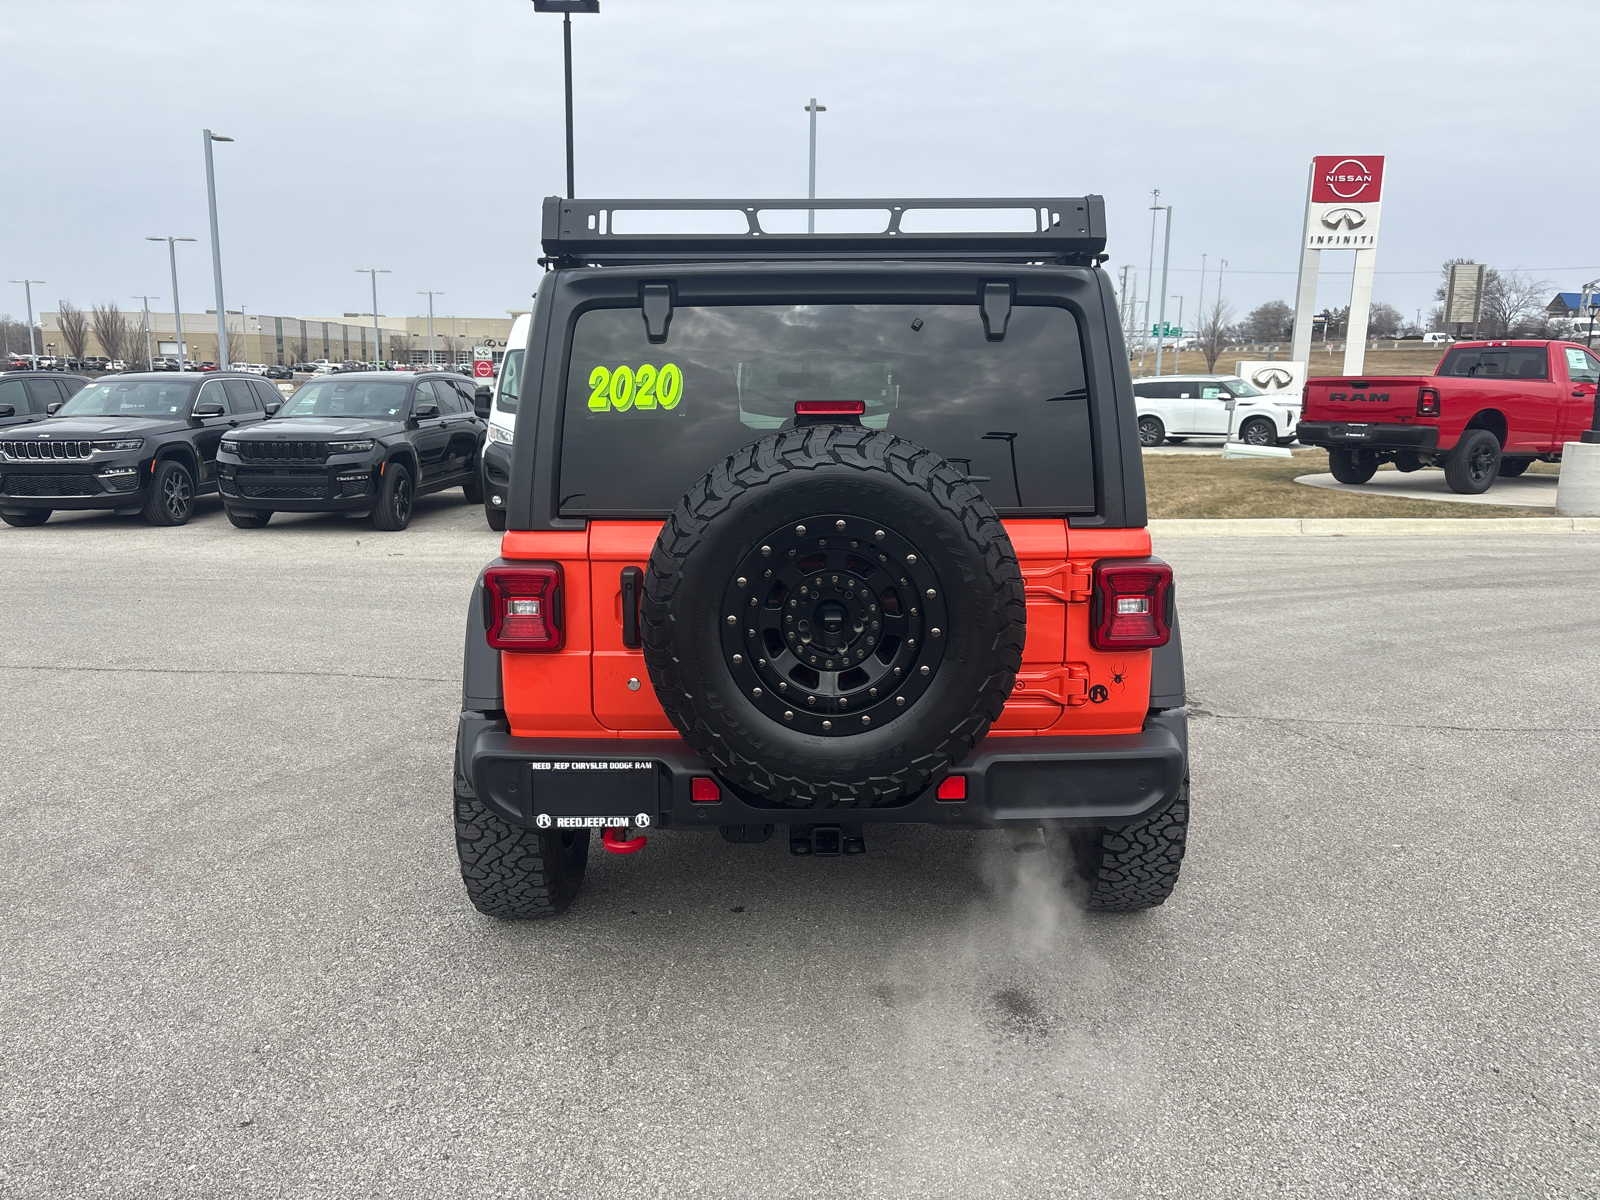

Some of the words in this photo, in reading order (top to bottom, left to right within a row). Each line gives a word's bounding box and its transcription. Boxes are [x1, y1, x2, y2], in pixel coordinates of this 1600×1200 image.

[1309, 236, 1374, 245] INFINITI
[587, 363, 684, 412] 2020
[1329, 393, 1390, 402] RAM
[532, 762, 551, 770] REED
[553, 762, 570, 770] JEEP
[571, 762, 608, 770] CHRYSLER
[609, 762, 634, 770] DODGE
[557, 817, 629, 828] REEDJEEP.COM
